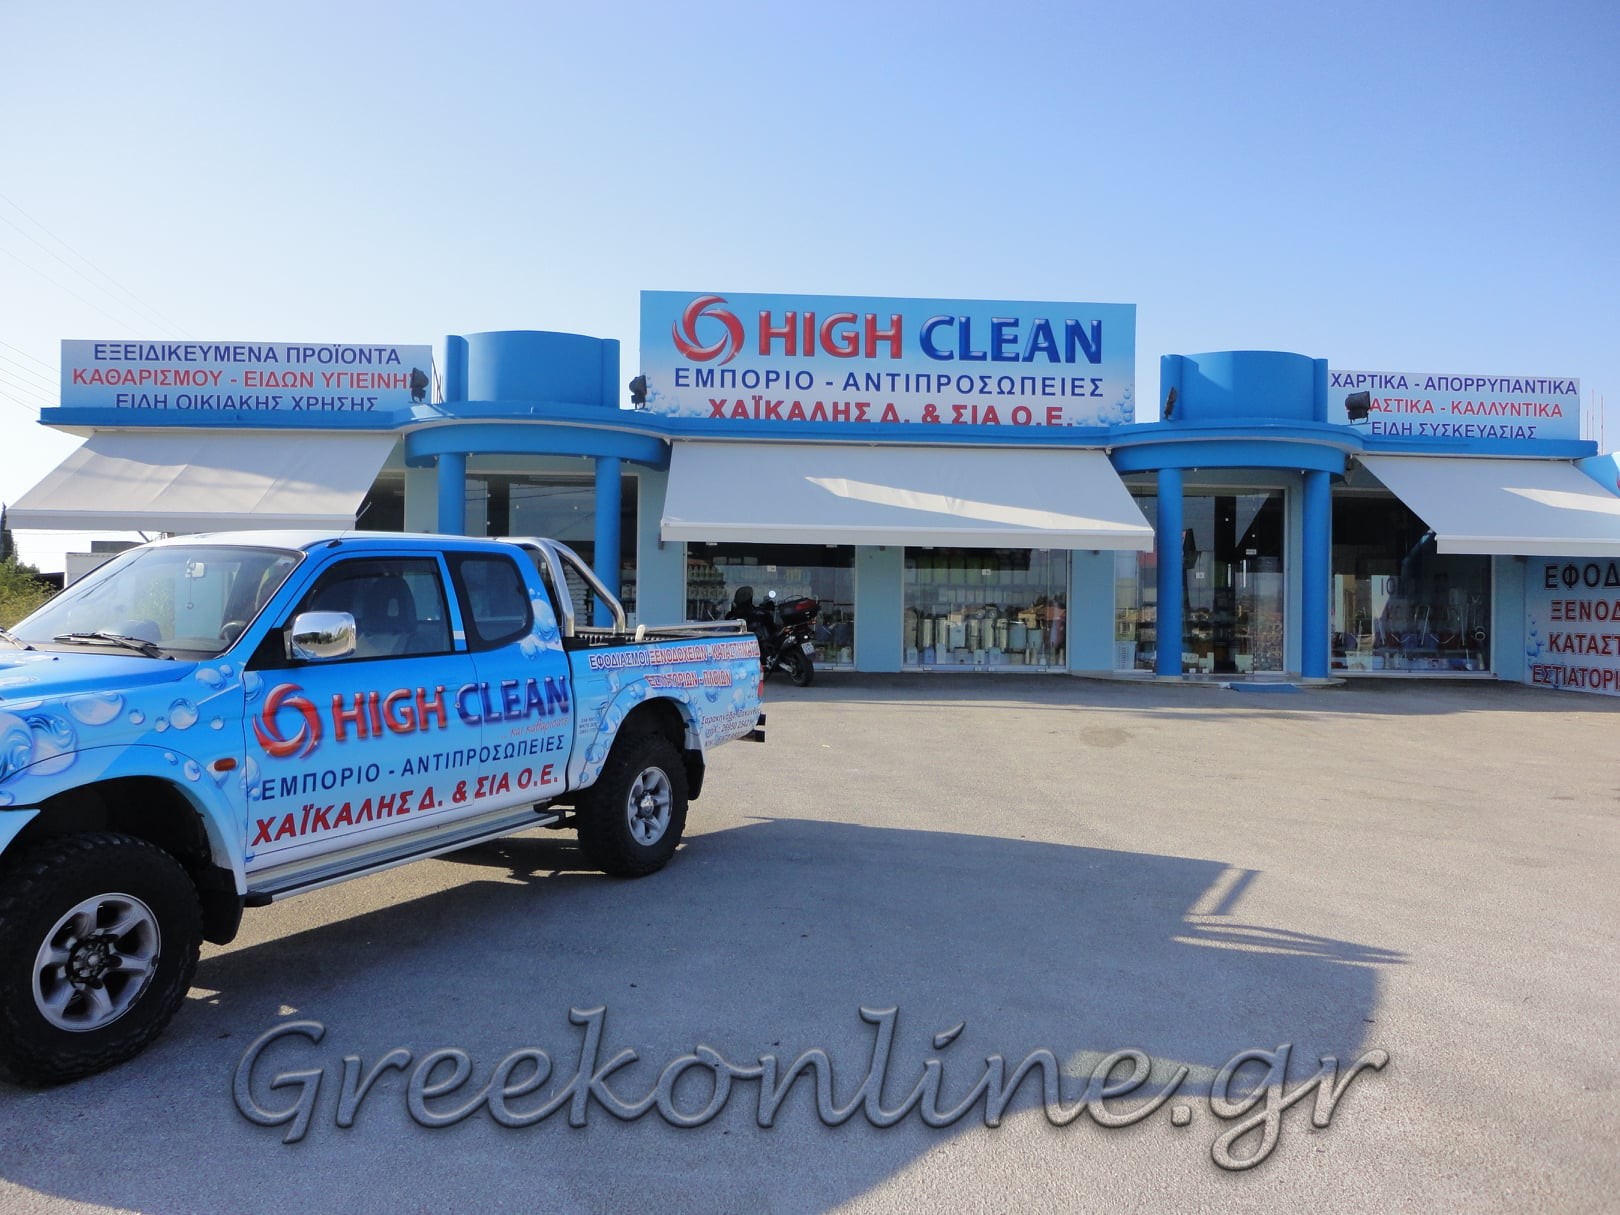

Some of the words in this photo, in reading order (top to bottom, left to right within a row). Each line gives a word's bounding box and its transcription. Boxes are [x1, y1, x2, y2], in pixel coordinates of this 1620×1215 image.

[758, 310, 903, 360] HIGH
[919, 314, 1102, 365] CLEAN
[94, 343, 278, 364] ΕΞΕΙΔΙΚΕΥΜΕΝΑ
[286, 342, 401, 365] ΠΡΟΪΟΝΤΑ
[73, 368, 223, 387] ΚΑΘΑΡΙΣΜΟΥ
[244, 371, 314, 389] ΕΙΔΩΝ
[321, 373, 411, 390] ΥΓΙΕΙΝΗ
[674, 367, 814, 391] ΕΜΠΟΡΙΟ
[842, 371, 1104, 398] ΑΝΤΙΠΡΟΣΩΠΕΙΕΣ
[1331, 373, 1408, 390] ΧΑΡΤΙΚΑ
[1424, 376, 1577, 395] ΑΠΟΡΡΥΠΑΝΤΙΚΑ
[175, 394, 283, 411] ΟΙΚΙΑΚΗΣ
[291, 395, 379, 412] ΧΡΗΣΗΣ
[708, 395, 871, 423] ΧΑΪΚΑΛΗΣ
[922, 403, 941, 424] &
[952, 404, 1000, 425] ΣΙΑ
[1011, 405, 1073, 427] Ο.Ε.
[1451, 400, 1563, 417] ΚΑΛΛΥΝΤΙΚΑ
[1371, 421, 1412, 437] ΕΙΔΗ
[1419, 423, 1537, 440] ΣΥΣΚΕΥΑΣΙΑΣ
[332, 685, 447, 742] HIGH
[456, 675, 570, 727] CLEAN
[261, 764, 380, 800] ΕΜΠΟΡΙΟ
[402, 734, 565, 777] ΑΝΤΙΠΡΟΣΩΠΕΙΕΣ
[251, 790, 414, 846] ΧΑΪΚΑΛΗΣ
[418, 787, 443, 811] Δ.
[452, 780, 467, 804] &
[473, 771, 511, 798] ΣΙΑ
[517, 763, 559, 790] Ο.Ε.
